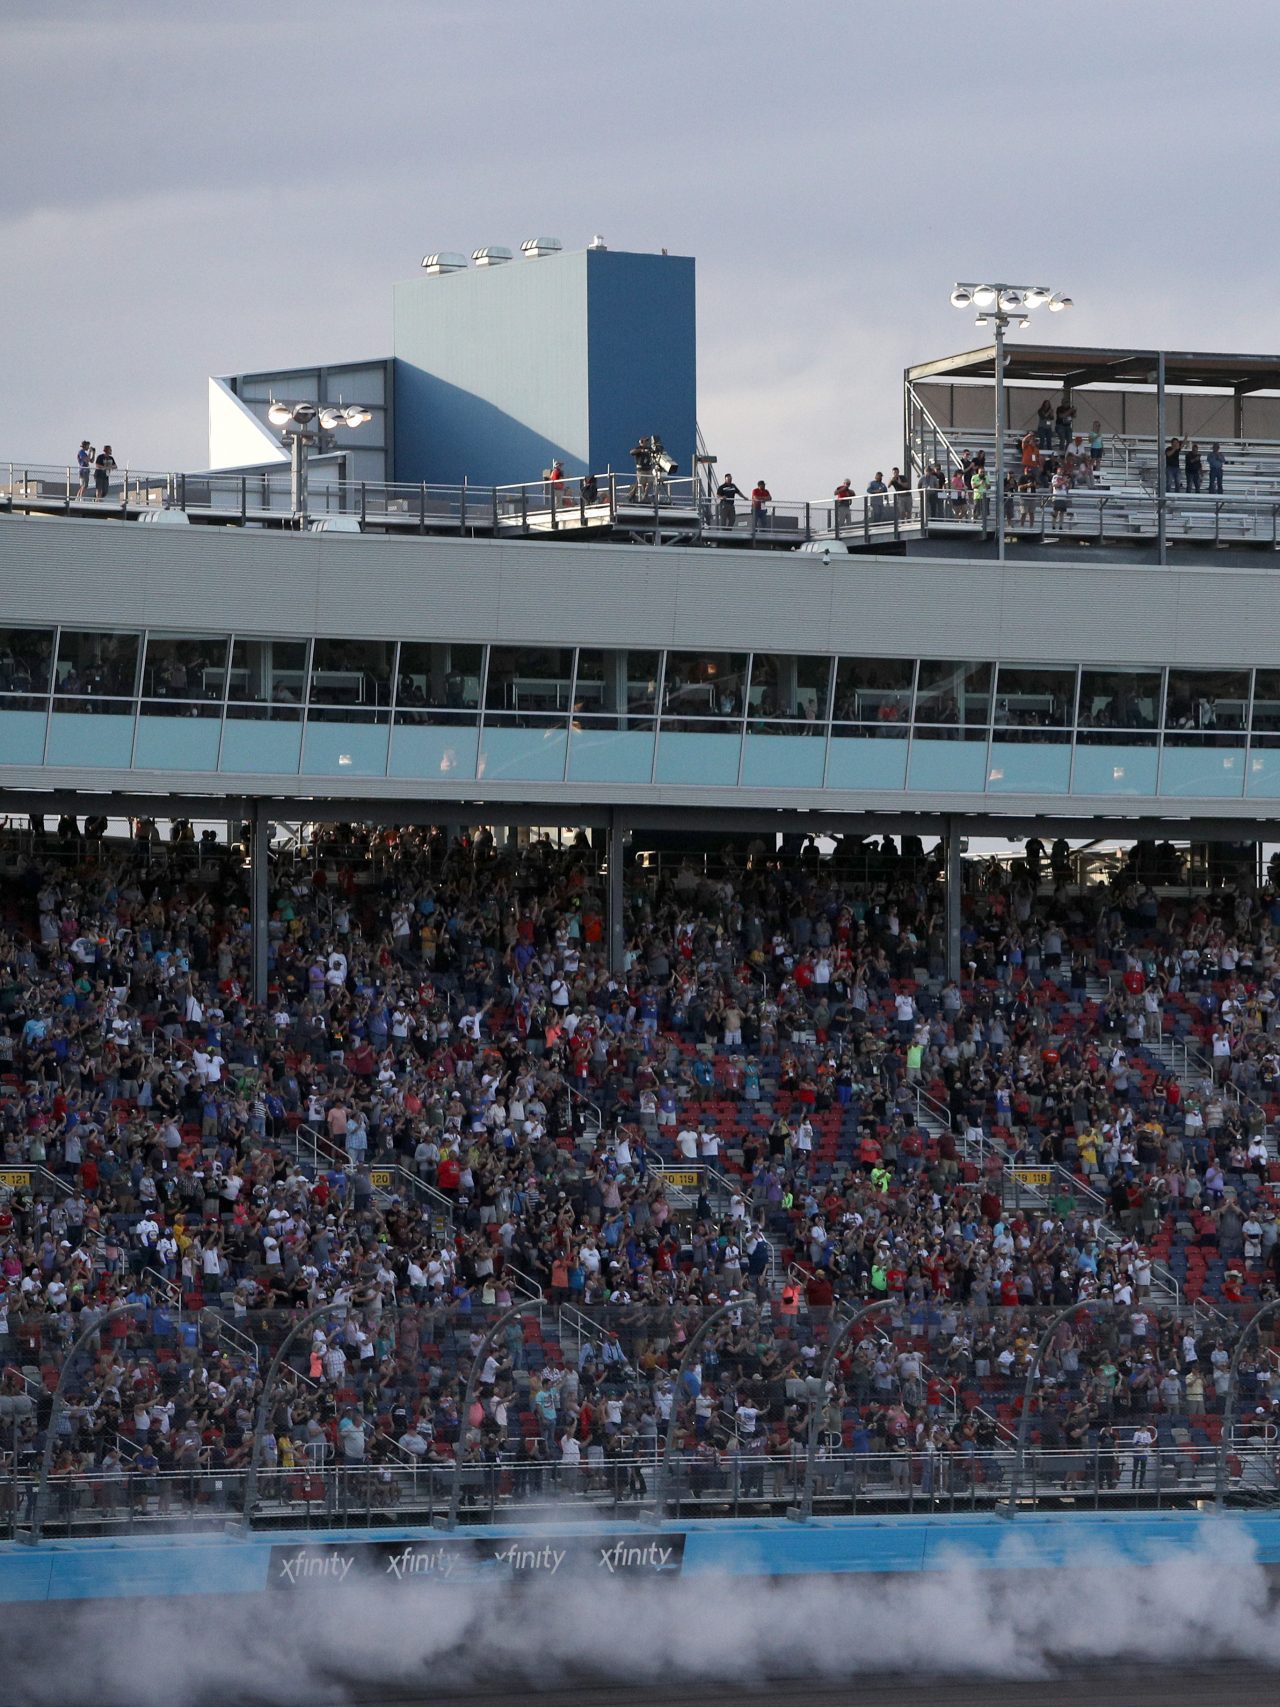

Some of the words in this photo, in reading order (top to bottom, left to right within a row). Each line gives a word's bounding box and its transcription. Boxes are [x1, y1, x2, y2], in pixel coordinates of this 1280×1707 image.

[12, 1175, 26, 1184] 121
[371, 1175, 387, 1184] 120
[680, 1175, 694, 1184] 119
[1033, 1174, 1047, 1183] 118
[600, 1541, 672, 1573] xfinity
[280, 1551, 354, 1583] xfinity
[386, 1547, 460, 1580] xfinity
